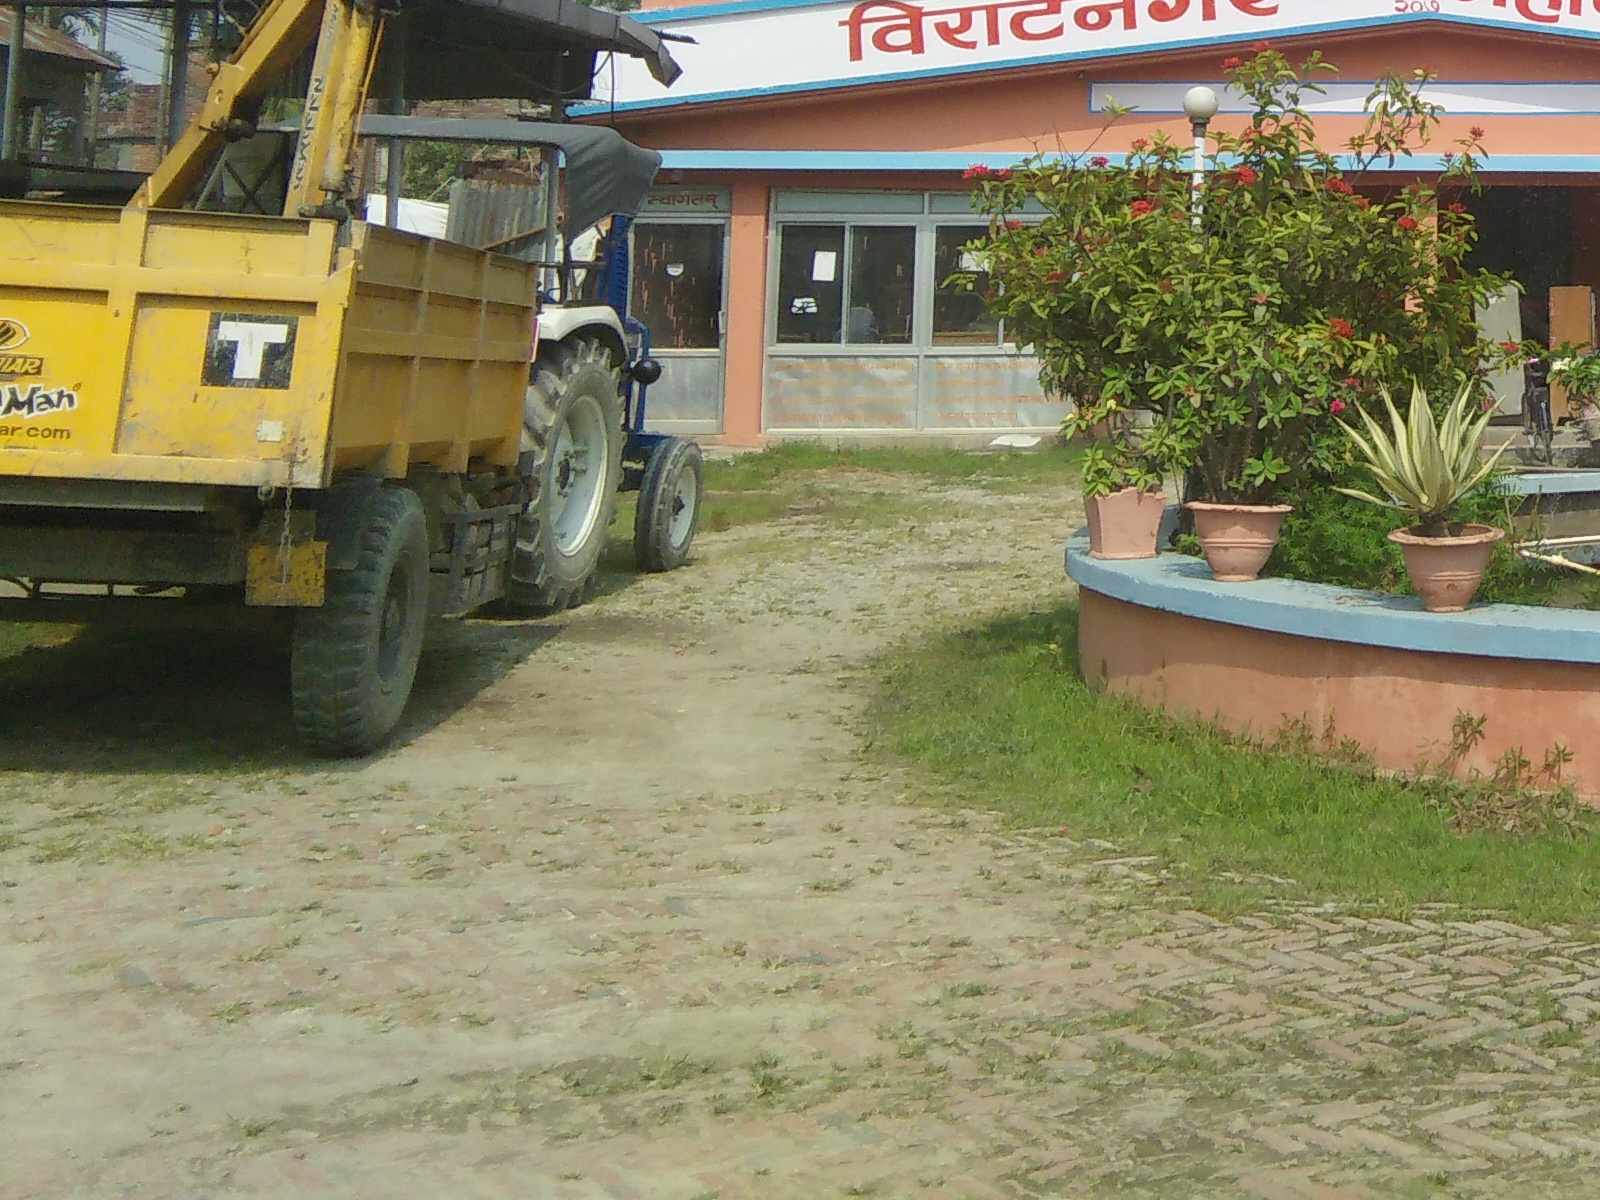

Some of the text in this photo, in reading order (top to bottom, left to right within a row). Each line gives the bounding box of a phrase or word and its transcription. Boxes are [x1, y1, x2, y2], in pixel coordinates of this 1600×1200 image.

[646, 192, 718, 210] स्वागतम्
[218, 321, 289, 379] T
[0, 386, 75, 416] Man
